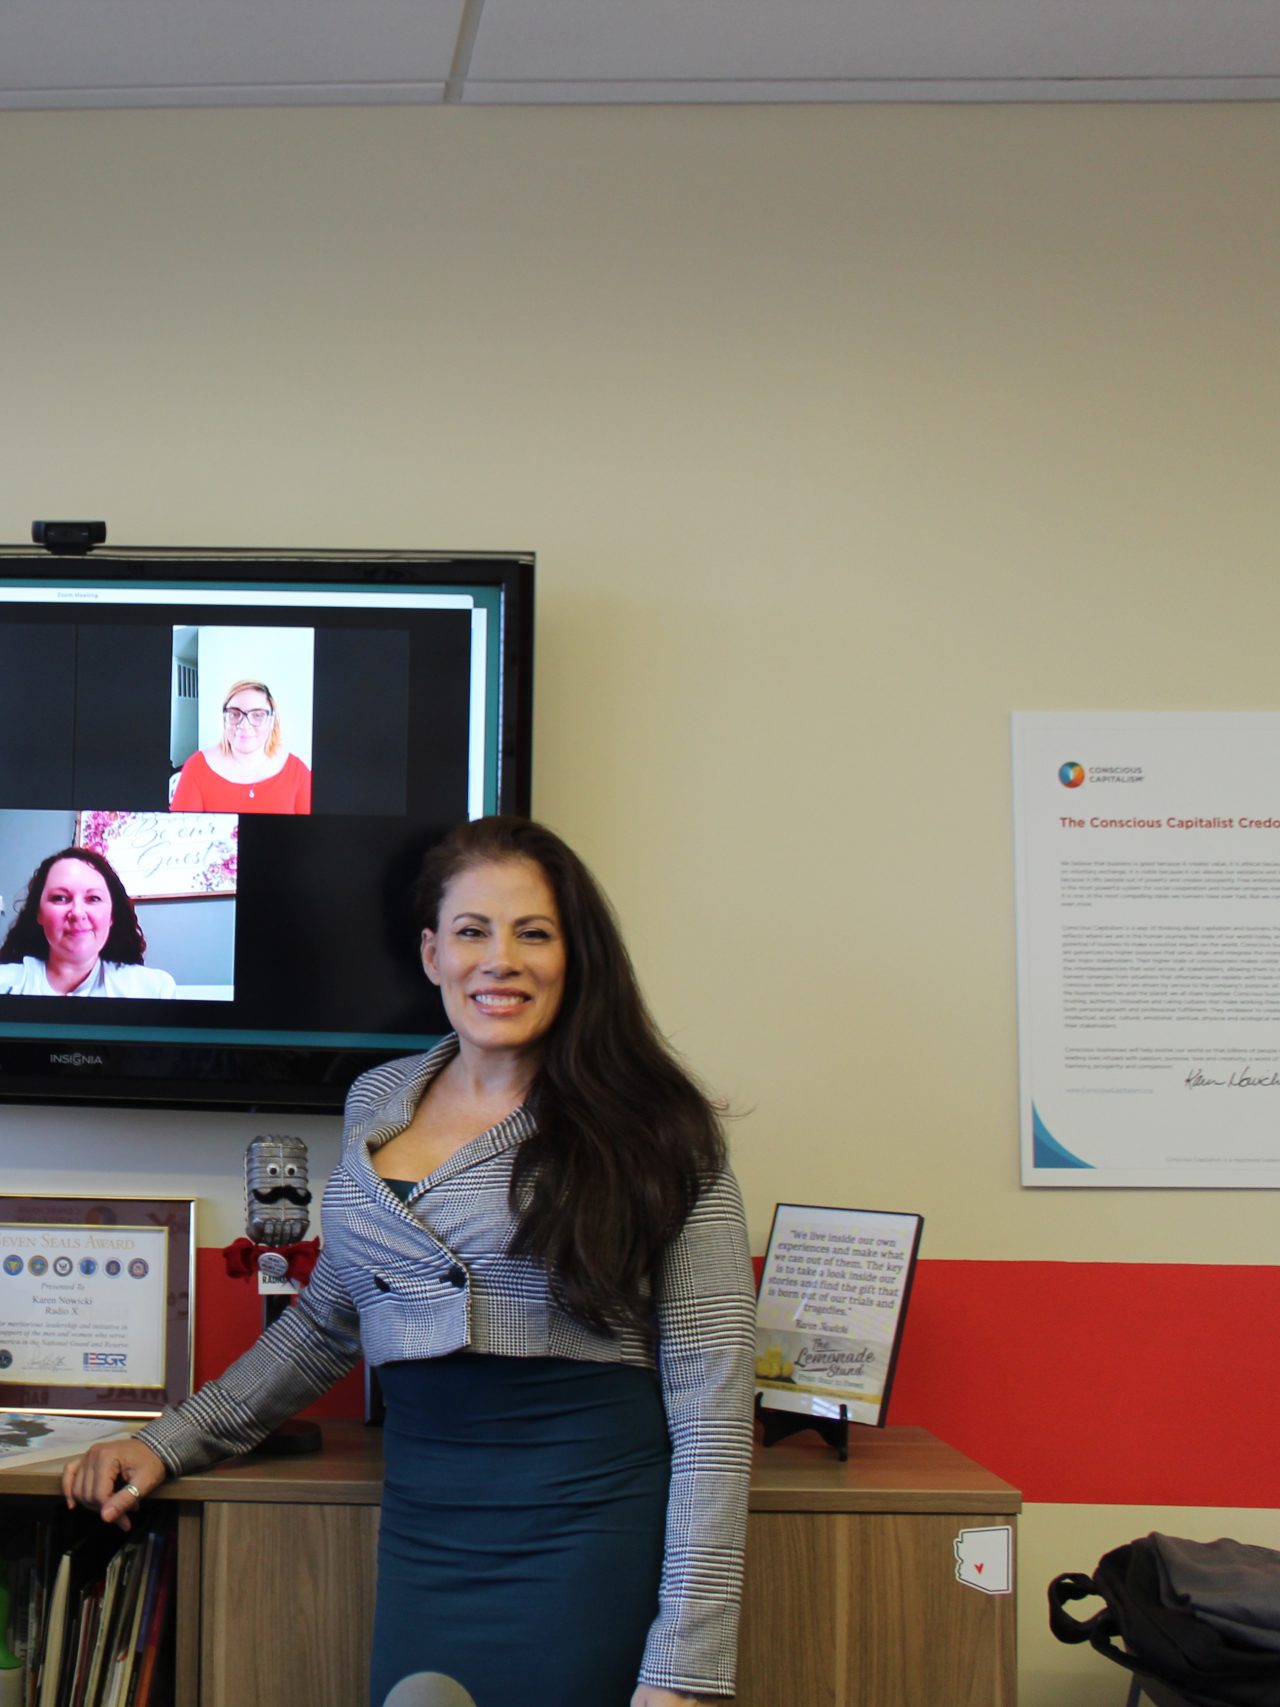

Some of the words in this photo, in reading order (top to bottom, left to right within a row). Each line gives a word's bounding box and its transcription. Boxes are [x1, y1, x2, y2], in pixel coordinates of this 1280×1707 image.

[1060, 817, 1085, 828] The
[1090, 817, 1162, 828] Conscious
[1166, 817, 1234, 830] Capitalist
[1238, 818, 1280, 829] Credo
[138, 841, 213, 878] Guest
[49, 1052, 103, 1066] INSIGNIA
[32, 1295, 56, 1304] Karen
[59, 1296, 92, 1305] Nowicki
[45, 1306, 69, 1315] Radio
[71, 1307, 78, 1315] X
[812, 1338, 831, 1350] The
[83, 1353, 127, 1366] ESGR
[794, 1347, 875, 1368] Lemonade
[827, 1364, 864, 1378] Stand
